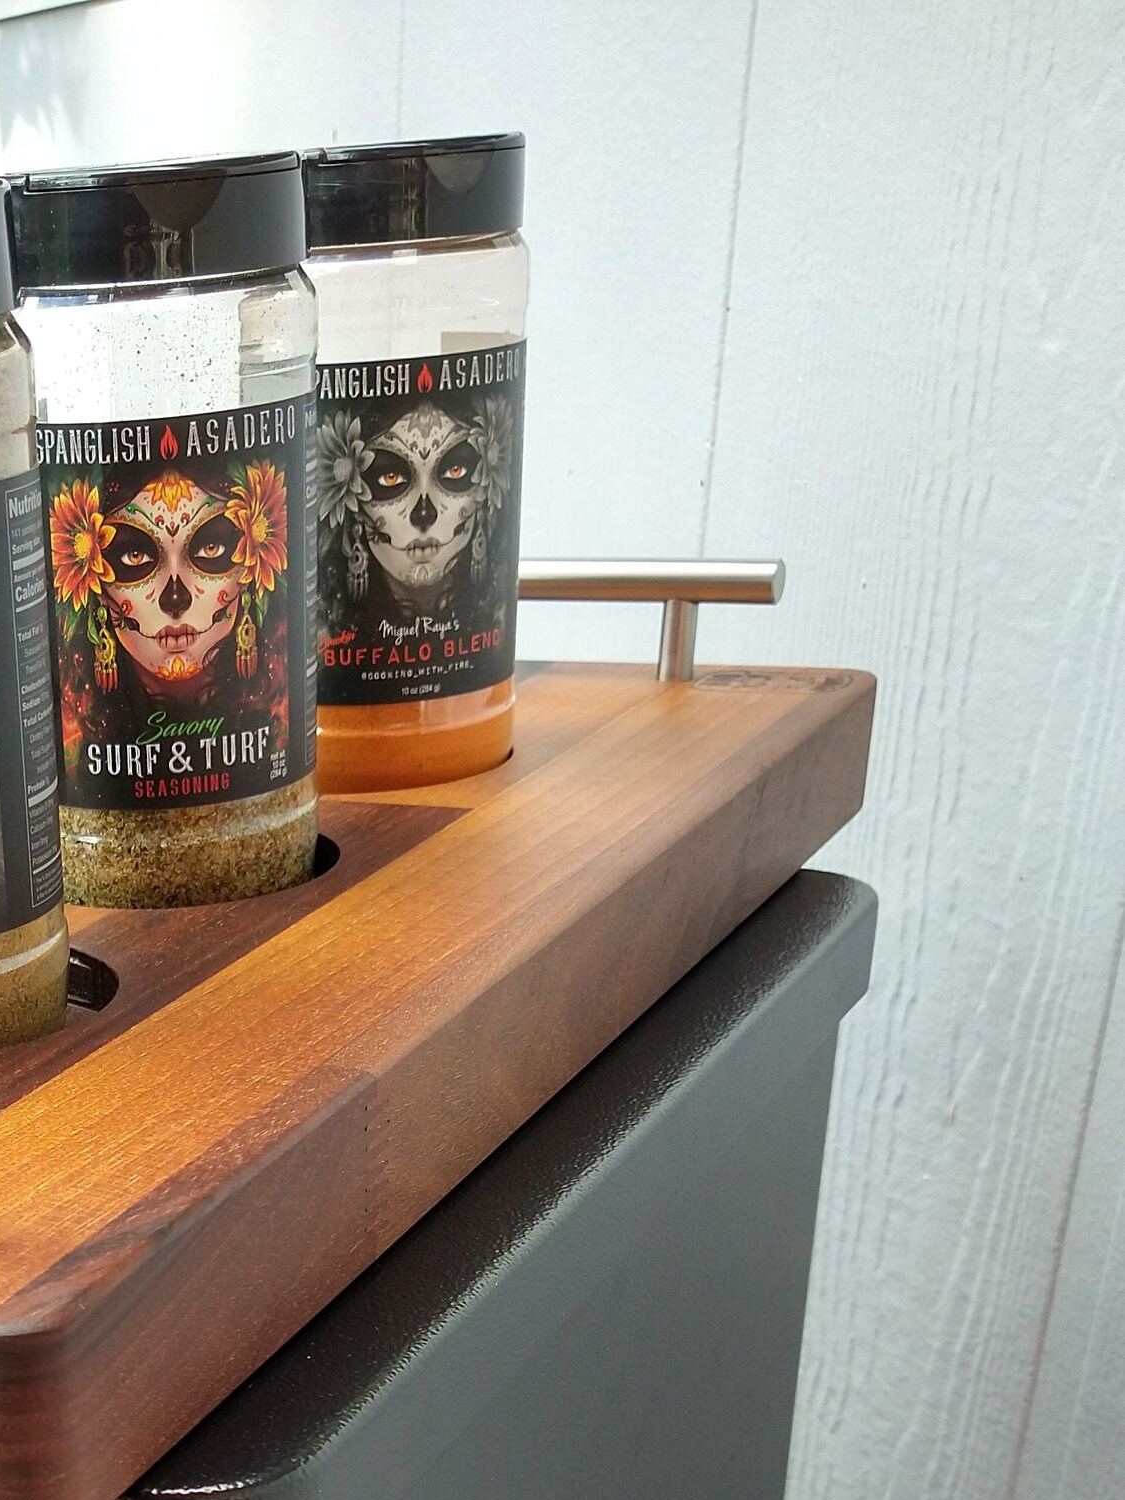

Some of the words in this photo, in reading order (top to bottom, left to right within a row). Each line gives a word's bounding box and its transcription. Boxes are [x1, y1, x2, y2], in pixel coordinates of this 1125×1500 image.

[439, 347, 521, 391] ASADERO
[36, 424, 151, 466] SPANGLISH
[186, 404, 295, 458] ASADERO
[15, 578, 46, 602] Calories
[324, 643, 433, 667] BUFFALO
[443, 628, 501, 658] BLEND
[378, 616, 420, 646] Miguel
[136, 711, 224, 745] Savory
[87, 743, 161, 778] SURF
[168, 741, 194, 774] &
[199, 726, 270, 770] TURF
[134, 772, 230, 798] SEASONING
